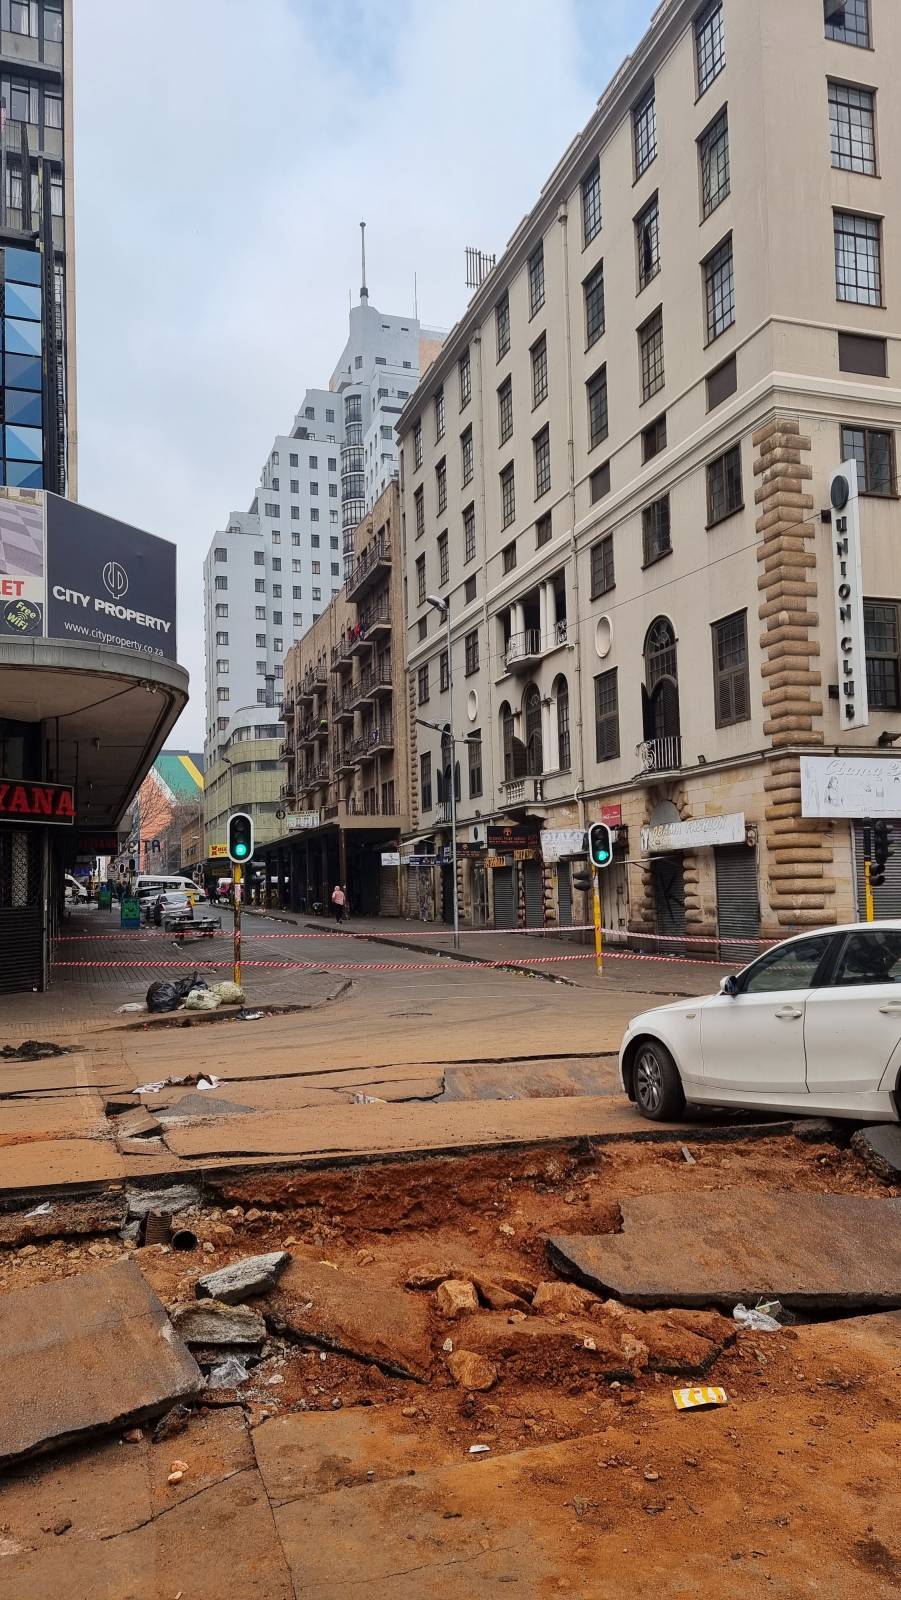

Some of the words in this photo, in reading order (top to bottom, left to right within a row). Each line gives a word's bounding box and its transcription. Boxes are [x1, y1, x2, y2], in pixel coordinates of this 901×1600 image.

[835, 516, 852, 624] UNION
[0, 580, 25, 597] ET
[7, 612, 29, 630] WiFi
[16, 601, 37, 619] Free
[52, 585, 91, 608] CITY
[94, 598, 171, 633] PROPERTY
[64, 621, 164, 657] www.cityproperty.co.za
[841, 636, 855, 720] CLUB
